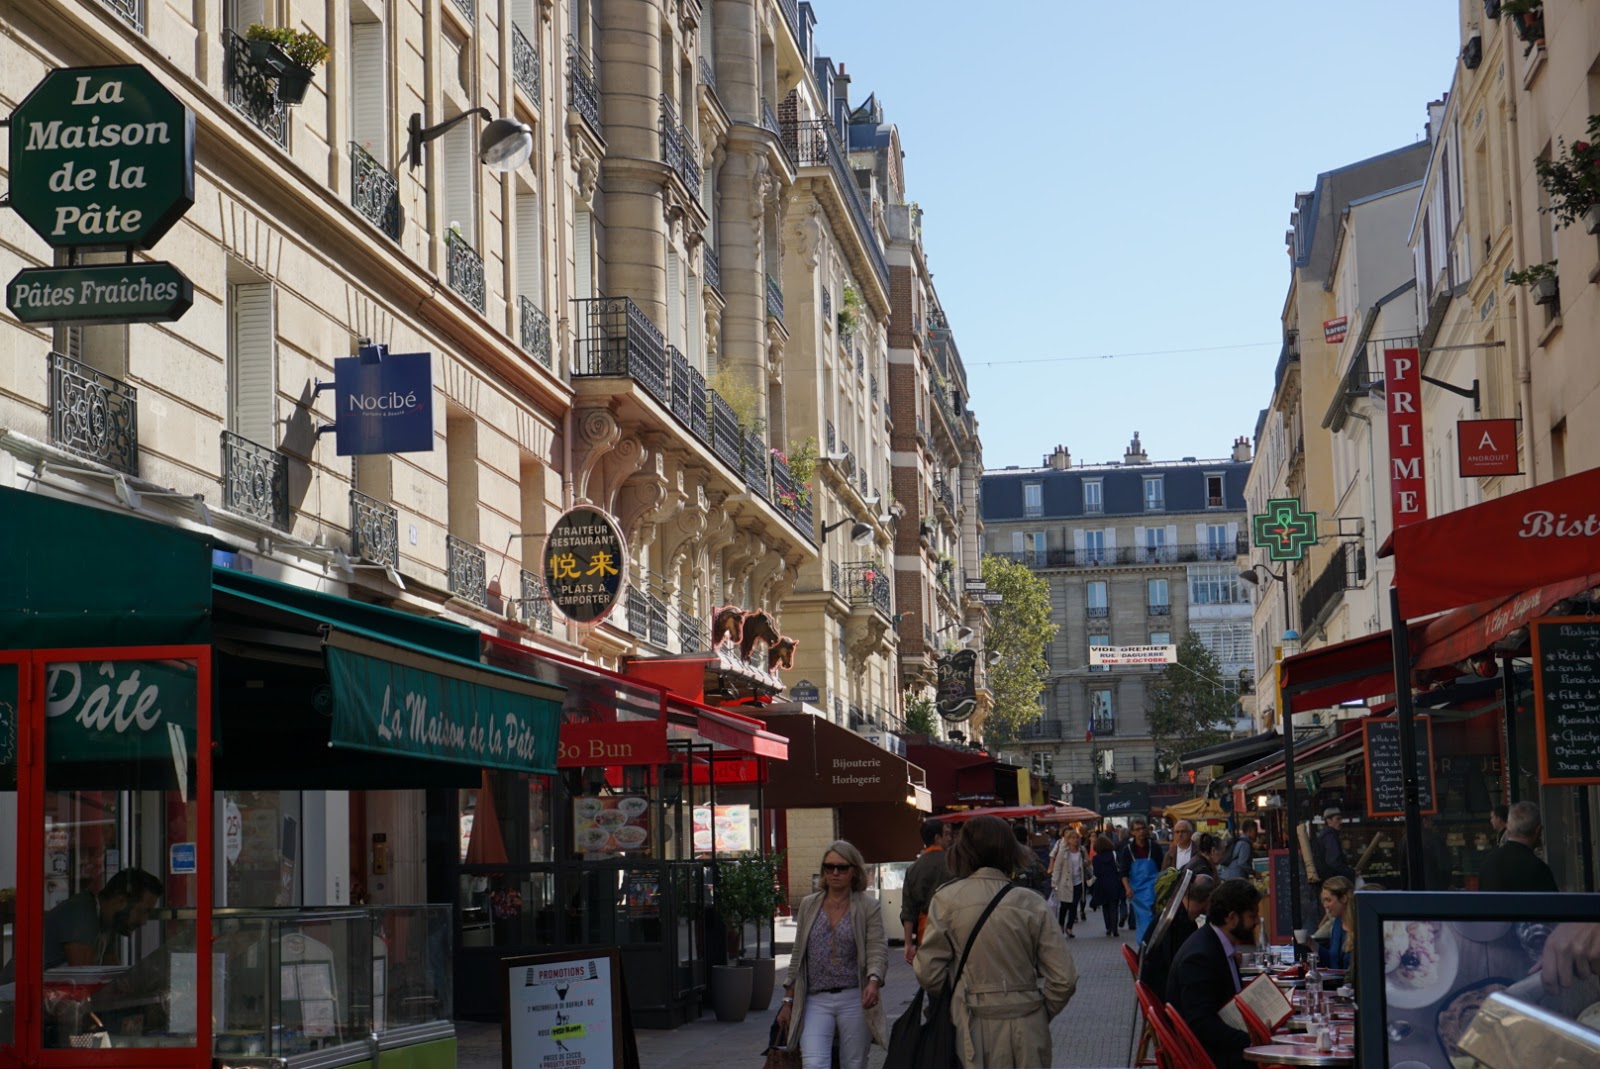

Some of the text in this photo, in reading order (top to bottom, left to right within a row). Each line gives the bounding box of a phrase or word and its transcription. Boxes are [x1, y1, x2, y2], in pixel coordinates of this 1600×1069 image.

[71, 75, 125, 106] La
[24, 117, 171, 151] Maison
[48, 158, 147, 193] de la
[51, 203, 142, 236] Pâte
[12, 276, 178, 309] Pâtes Fraîches
[349, 390, 417, 411] Nocibé
[1391, 358, 1423, 528] PRIME
[1478, 430, 1498, 452] A
[1467, 454, 1510, 462] ANDROUET
[558, 524, 608, 536] TRAITEUR
[1518, 510, 1600, 538] Bist
[551, 536, 615, 548] RESTAURANT
[562, 584, 606, 594] PLATS A
[558, 594, 610, 606] EMPORTER
[378, 684, 536, 760] La Maison de la Pâte
[588, 739, 633, 758] Bun
[832, 758, 881, 770] Bijouterie
[832, 774, 880, 787] Horlogerie
[538, 966, 585, 980] PROMOTIONS
[566, 1000, 584, 1009] BUFALA
